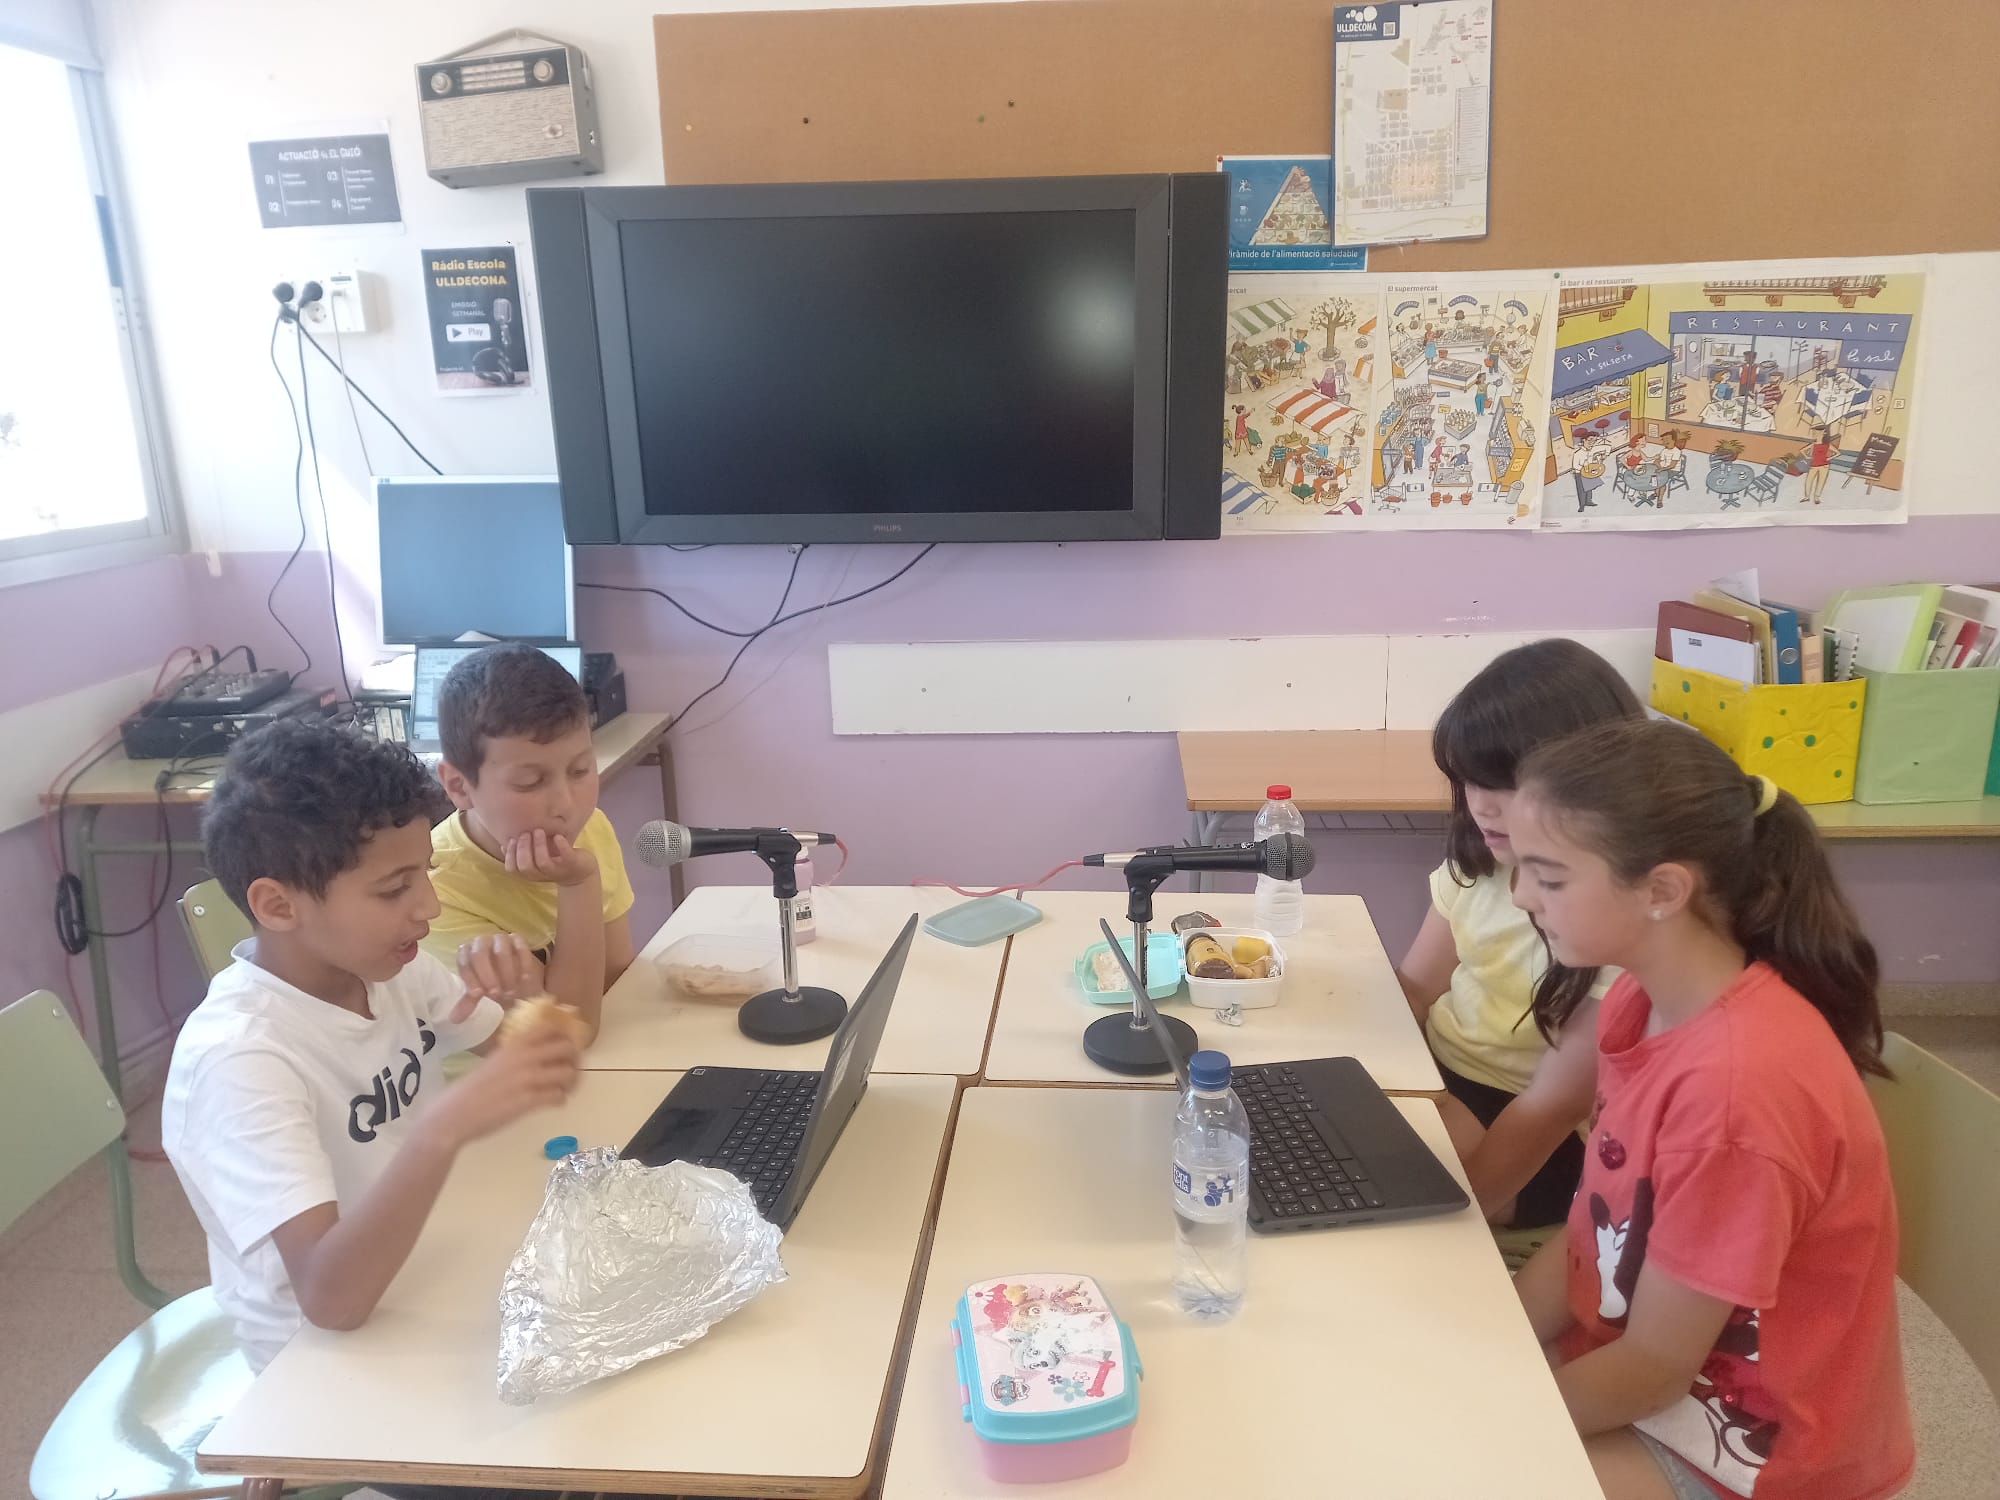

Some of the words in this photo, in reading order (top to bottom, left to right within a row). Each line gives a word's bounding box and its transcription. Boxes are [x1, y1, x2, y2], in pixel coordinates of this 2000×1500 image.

[1336, 22, 1378, 33] ULLDECONA
[1229, 249, 1259, 258] iràmide
[1261, 249, 1270, 258] de
[1271, 249, 1320, 259] l'alimentació
[1321, 249, 1358, 258] saludable
[466, 258, 506, 270] Escola
[435, 275, 507, 287] ULLDECONA
[1395, 285, 1439, 293] supermercat
[1687, 317, 1899, 333] RESTAURANT
[467, 327, 484, 338] Play
[1561, 347, 1599, 371] BAR
